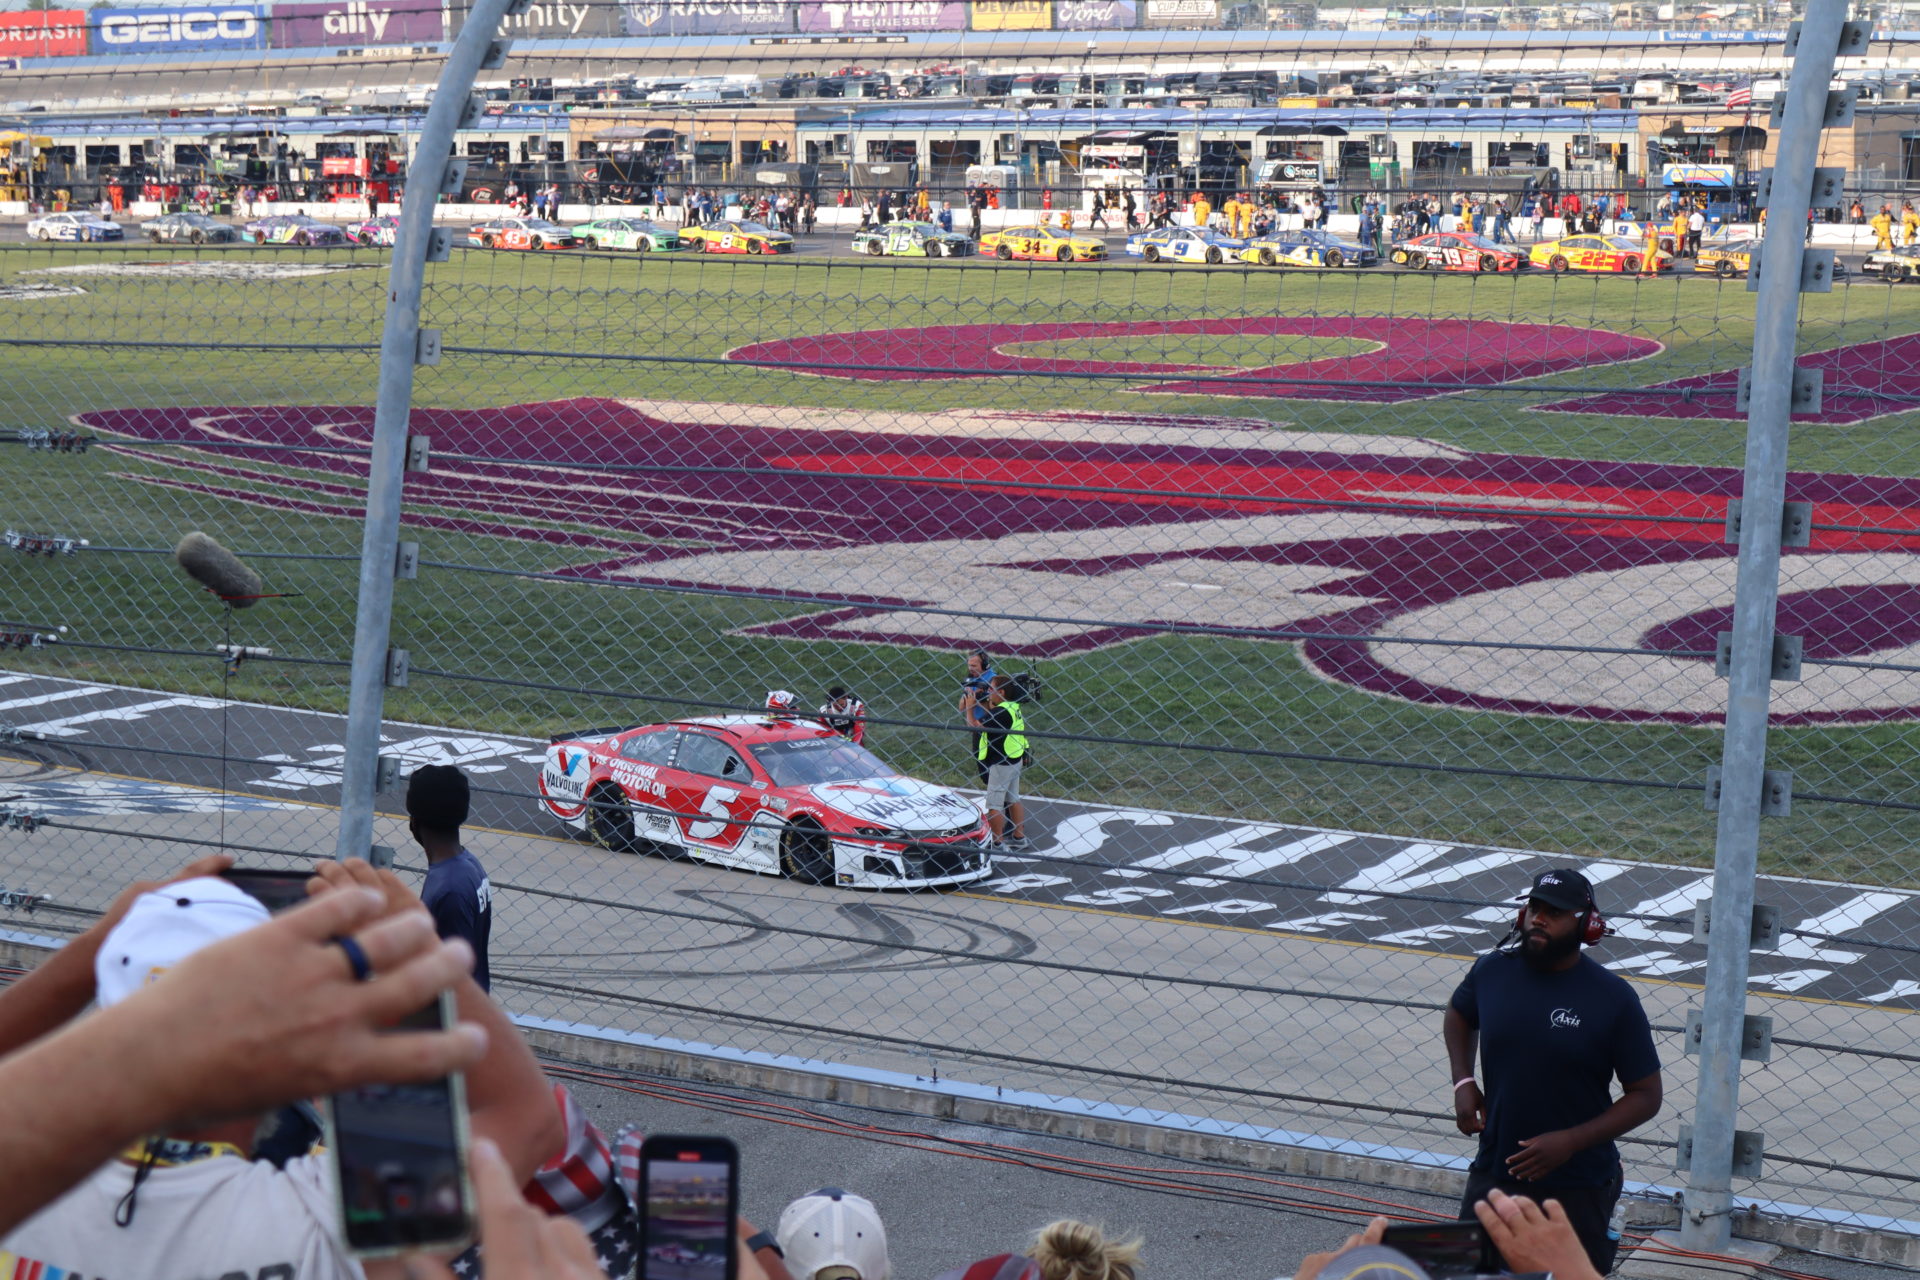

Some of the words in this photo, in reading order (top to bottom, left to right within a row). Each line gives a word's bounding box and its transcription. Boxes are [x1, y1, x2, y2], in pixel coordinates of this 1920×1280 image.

[741, 14, 785, 24] ROOFING
[1058, 0, 1114, 22] Ford
[101, 11, 257, 44] GEICO
[324, 1, 391, 40] ally
[852, 17, 940, 28] TENNESSEE
[1295, 166, 1317, 177] Smart
[504, 231, 520, 244] 43
[1617, 225, 1630, 236] 9
[720, 234, 734, 249] 8
[892, 236, 911, 251] 15
[1022, 239, 1041, 254] 34
[1174, 242, 1190, 257] 9
[1403, 243, 1442, 252] TRACKER
[1442, 248, 1463, 265] 19
[1580, 251, 1606, 267] 22
[609, 758, 660, 780] ORIGINAL
[546, 770, 584, 798] VALVOLINE
[610, 769, 652, 794] MOTOR
[651, 780, 667, 799] OIL
[687, 784, 742, 839] 5
[858, 794, 958, 820] VALVOLINE
[1555, 1011, 1581, 1027] Axis
